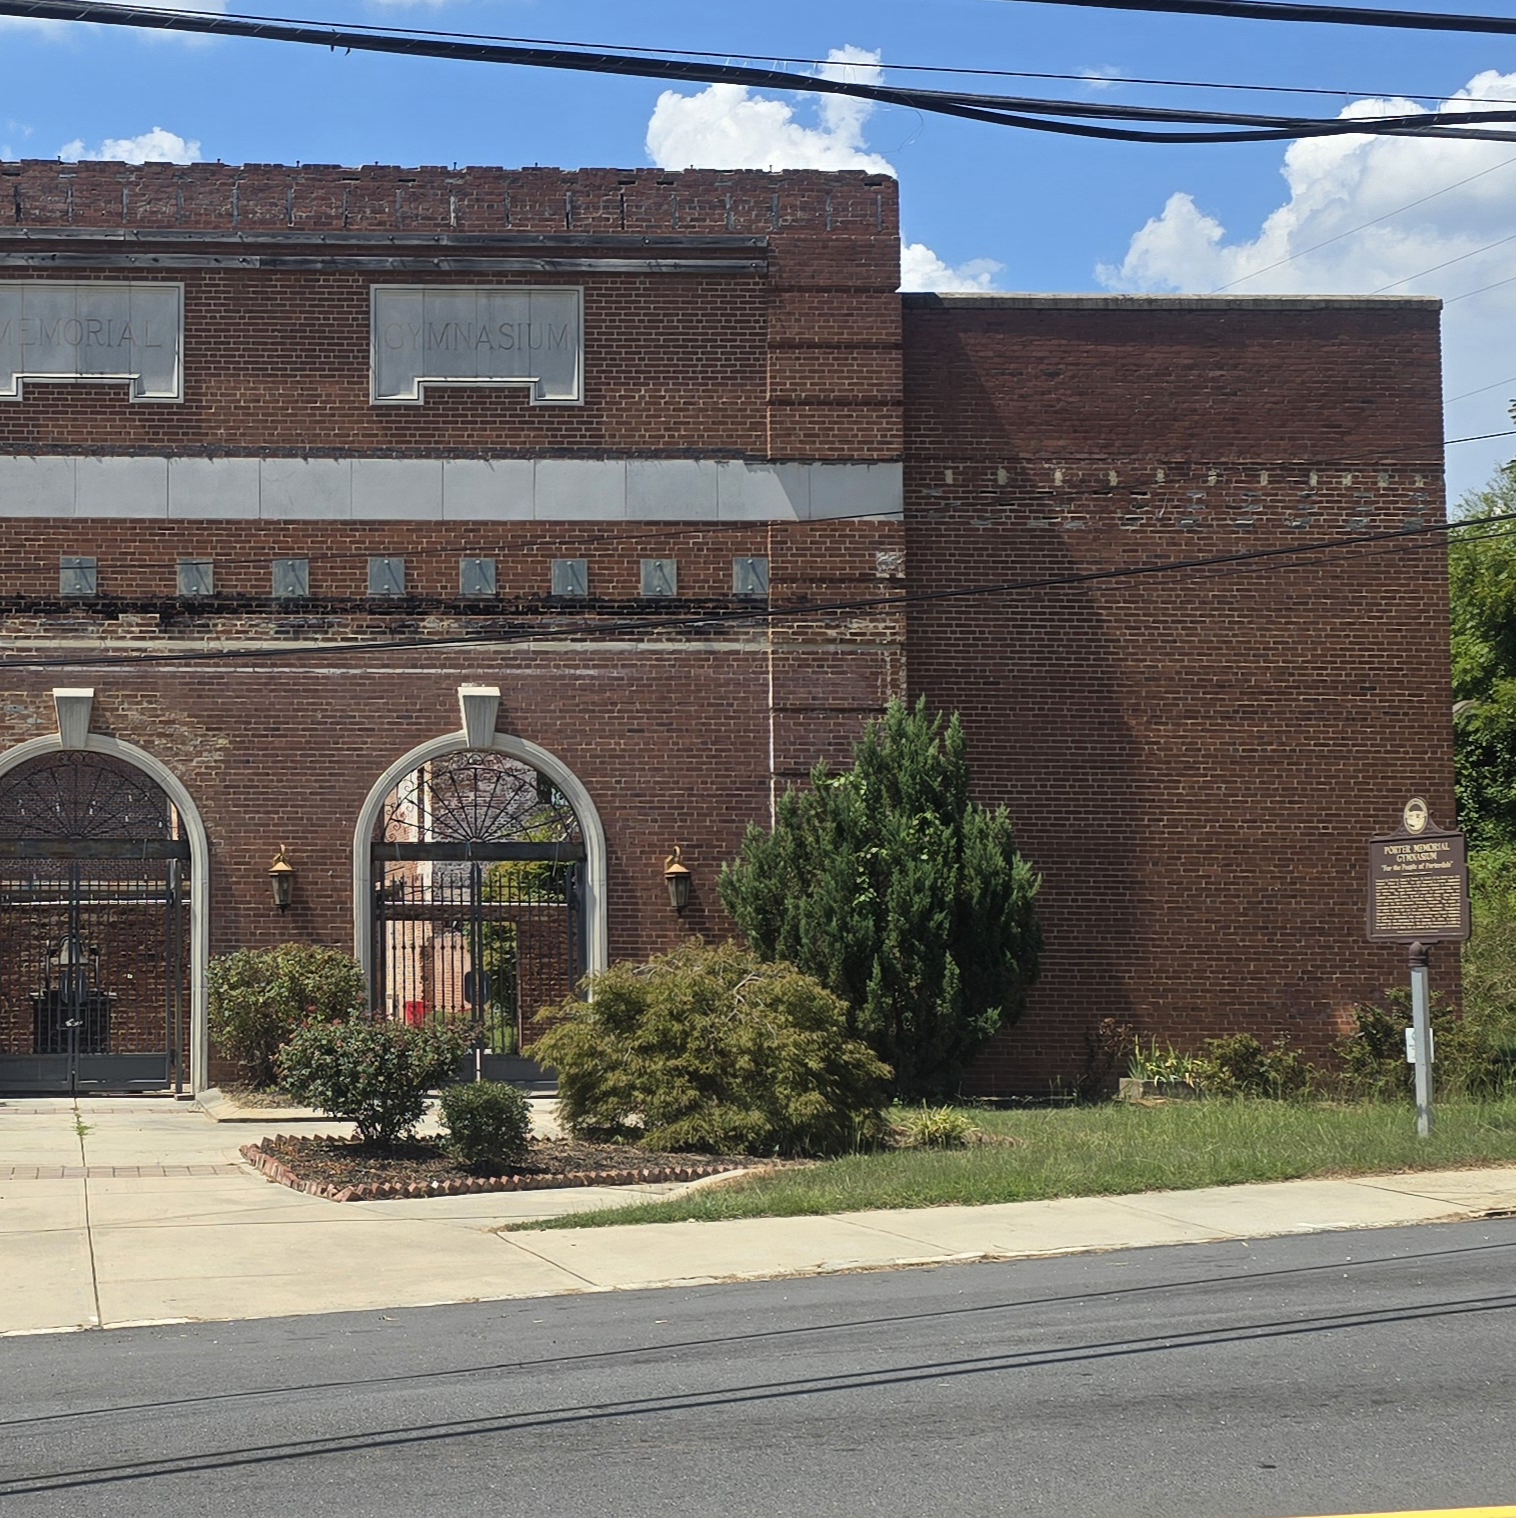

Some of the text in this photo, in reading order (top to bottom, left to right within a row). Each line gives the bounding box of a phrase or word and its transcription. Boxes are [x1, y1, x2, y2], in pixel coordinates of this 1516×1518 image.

[384, 322, 568, 350] GYMNASIUM
[1384, 842, 1450, 854] PORTER MEMORIAL
